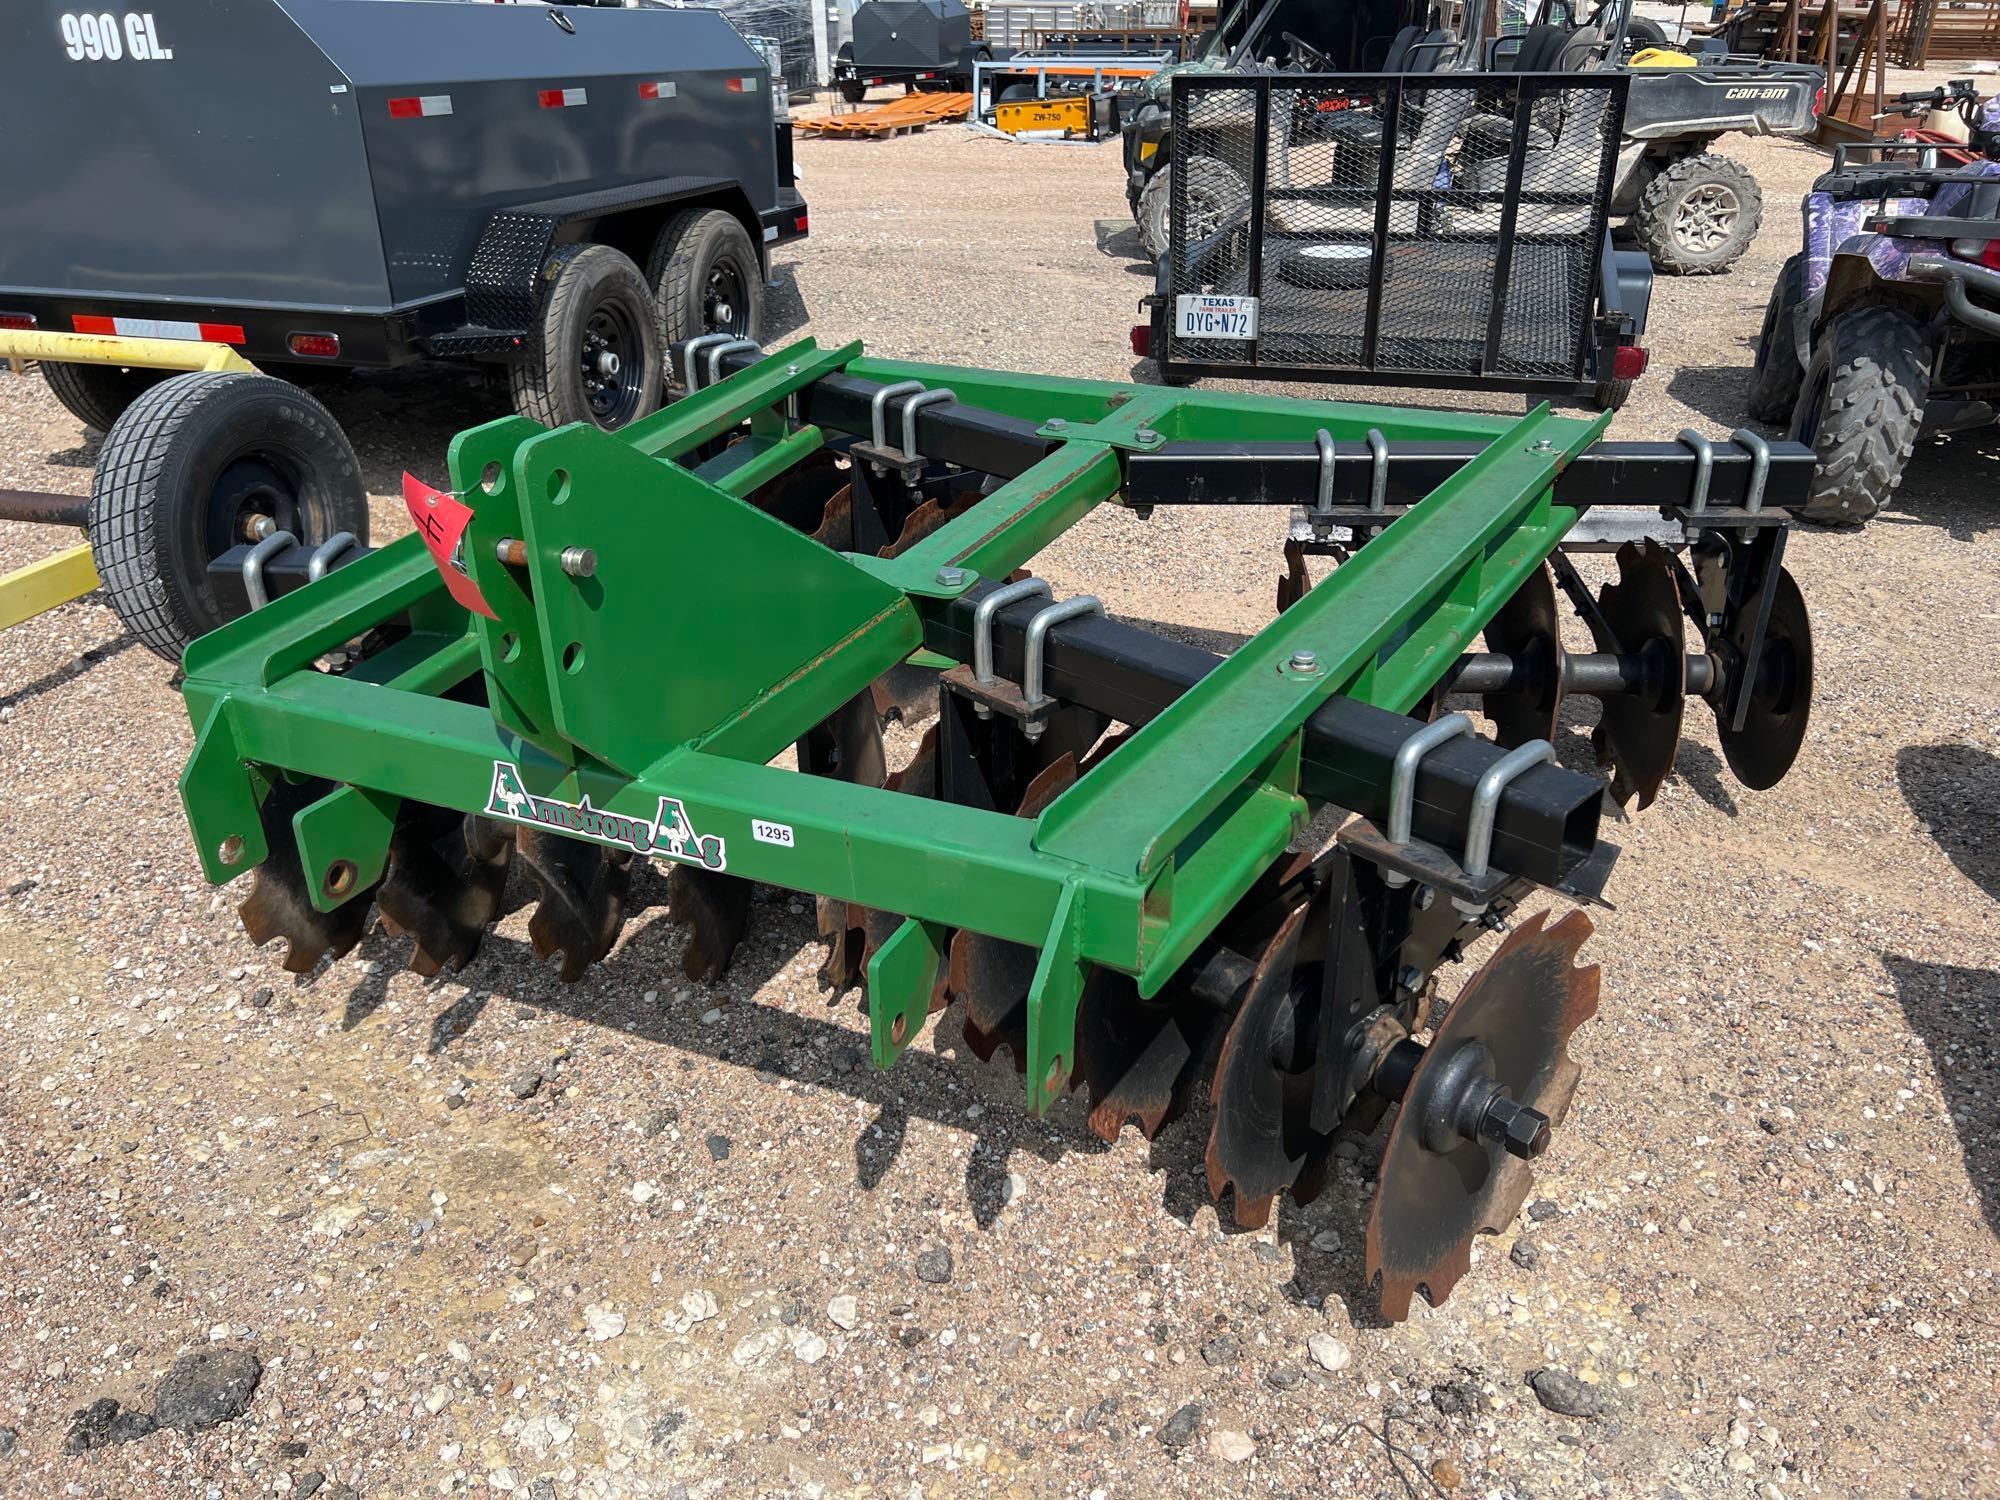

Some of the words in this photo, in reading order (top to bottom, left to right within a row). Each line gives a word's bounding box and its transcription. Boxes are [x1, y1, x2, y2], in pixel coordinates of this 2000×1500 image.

[61, 13, 123, 61] 990
[124, 12, 173, 60] GL.
[1033, 112, 1062, 122] ZW-750
[1202, 297, 1235, 307] TEXAS
[757, 824, 790, 842] 1295
